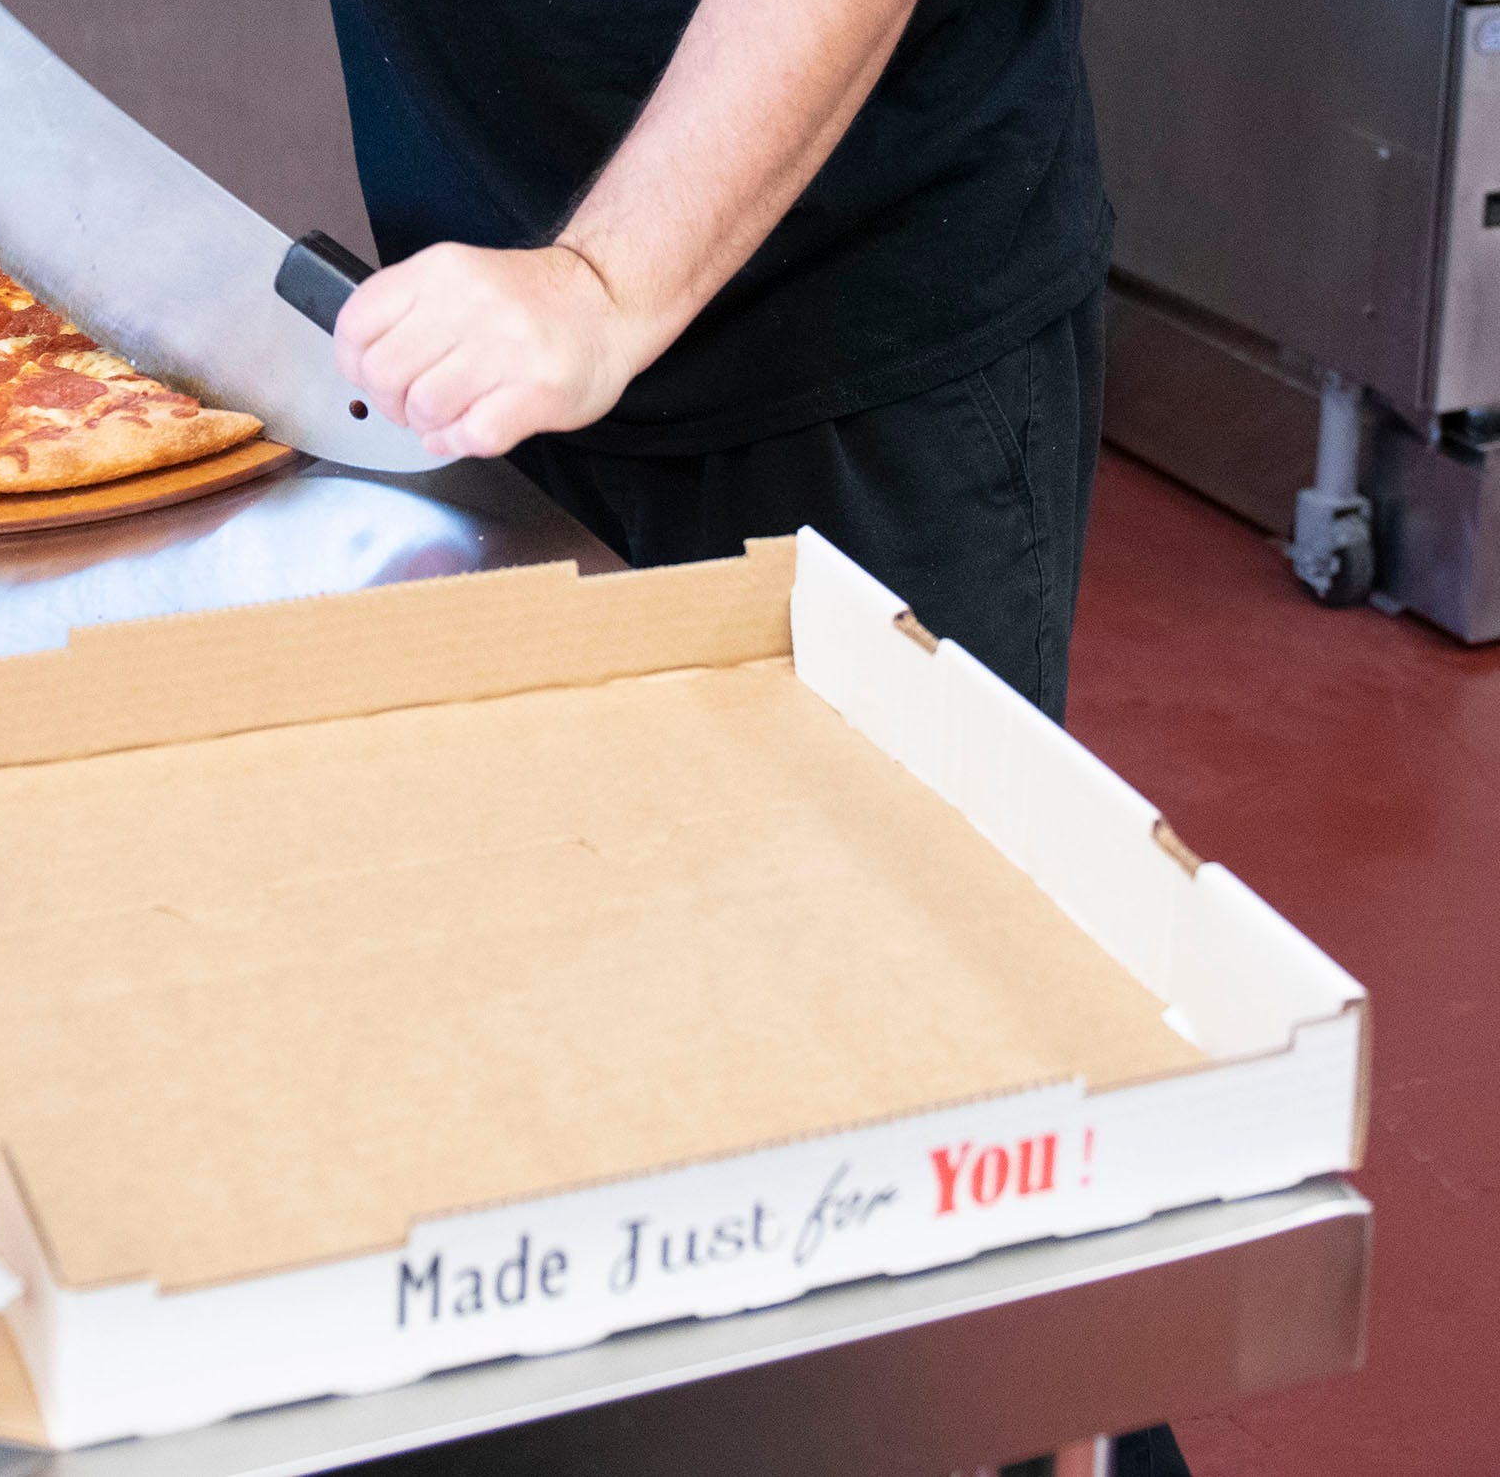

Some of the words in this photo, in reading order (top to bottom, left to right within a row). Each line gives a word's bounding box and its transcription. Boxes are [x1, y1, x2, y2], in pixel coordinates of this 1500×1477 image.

[396, 1233, 568, 1328] Made
[609, 1199, 783, 1295] Just
[793, 1160, 899, 1268] for
